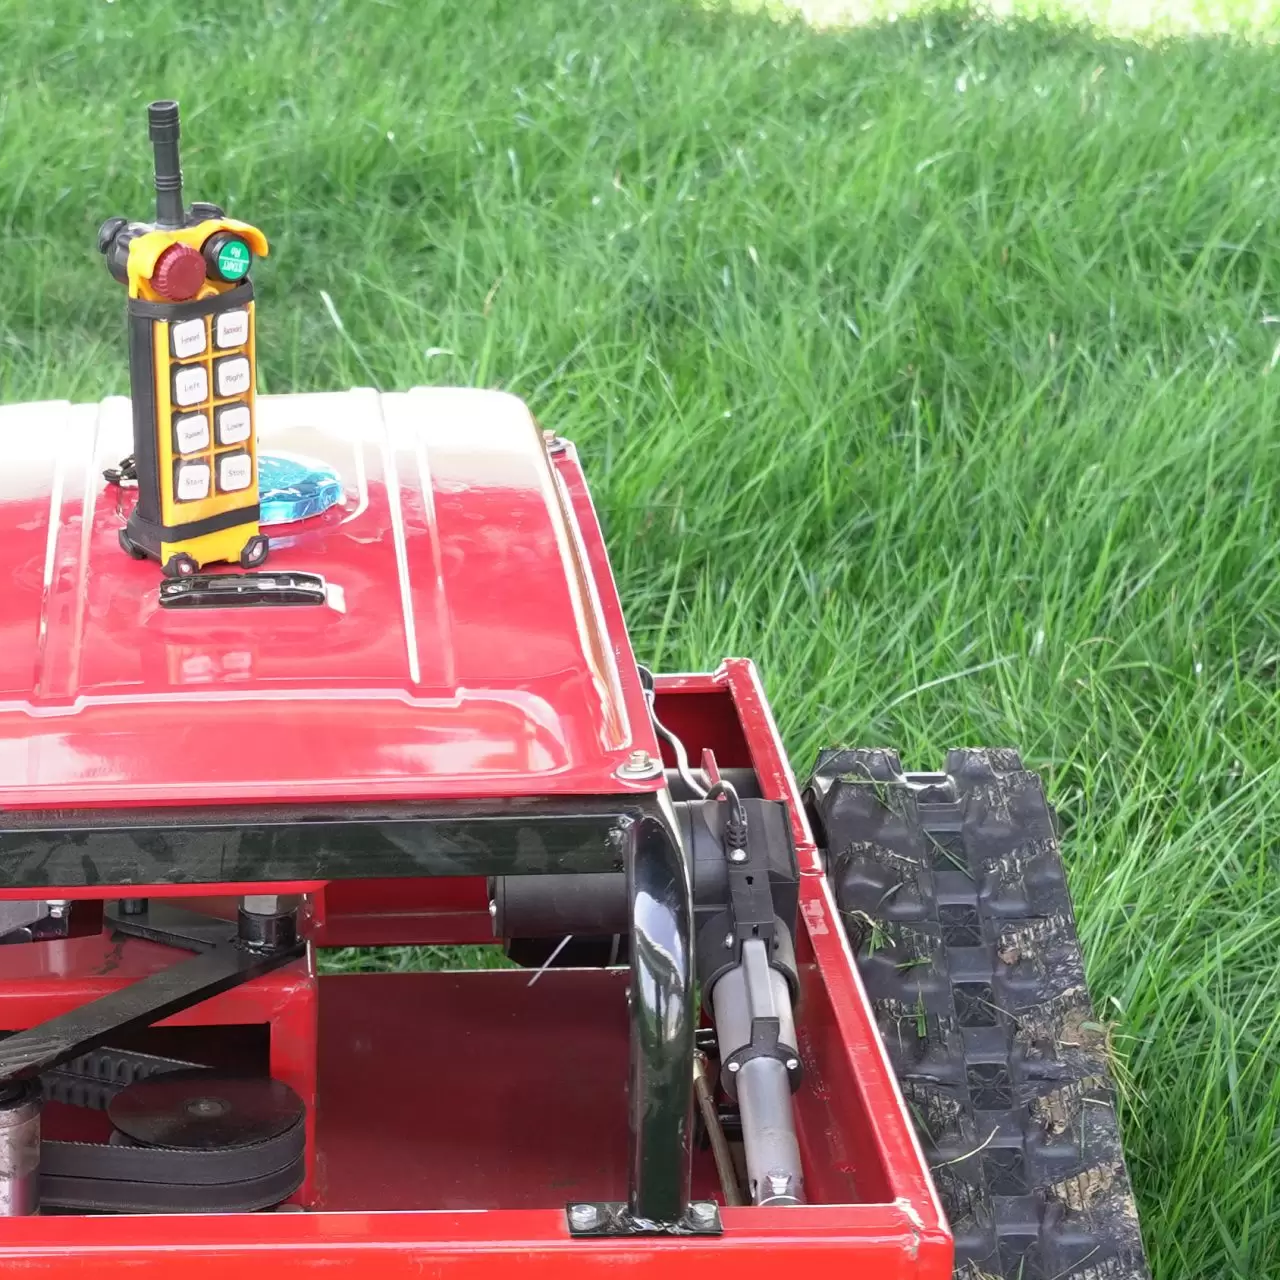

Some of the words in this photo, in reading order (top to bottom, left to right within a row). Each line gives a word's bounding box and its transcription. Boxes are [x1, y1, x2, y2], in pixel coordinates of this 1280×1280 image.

[225, 373, 244, 384] Right
[184, 382, 200, 392] Left
[228, 469, 245, 477] Stop
[186, 478, 204, 486] Start
